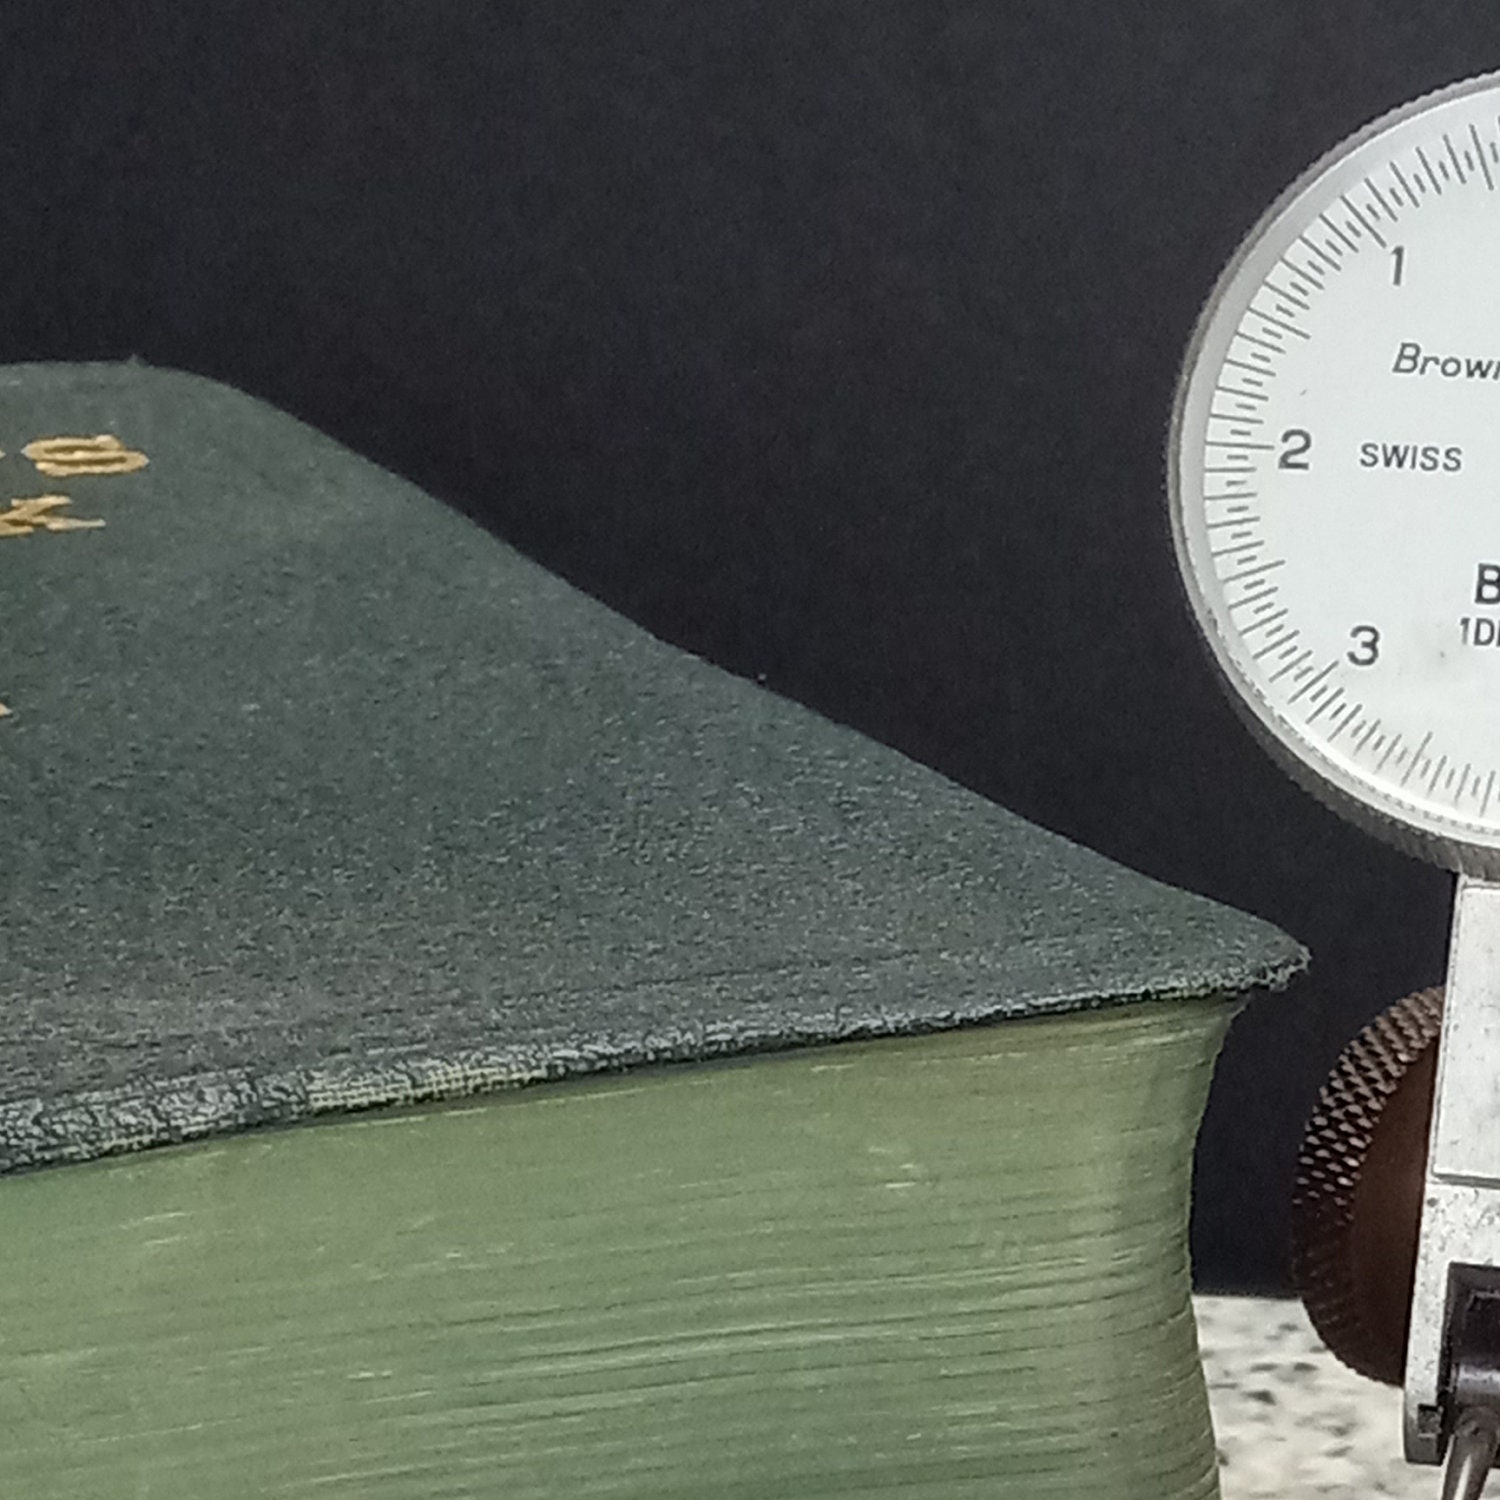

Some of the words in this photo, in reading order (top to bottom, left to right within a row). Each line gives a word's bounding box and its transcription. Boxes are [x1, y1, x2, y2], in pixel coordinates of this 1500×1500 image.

[1391, 246, 1405, 286] 1
[1278, 429, 1312, 471] 2
[1360, 443, 1462, 473] SWISS
[1347, 625, 1381, 666] 3
